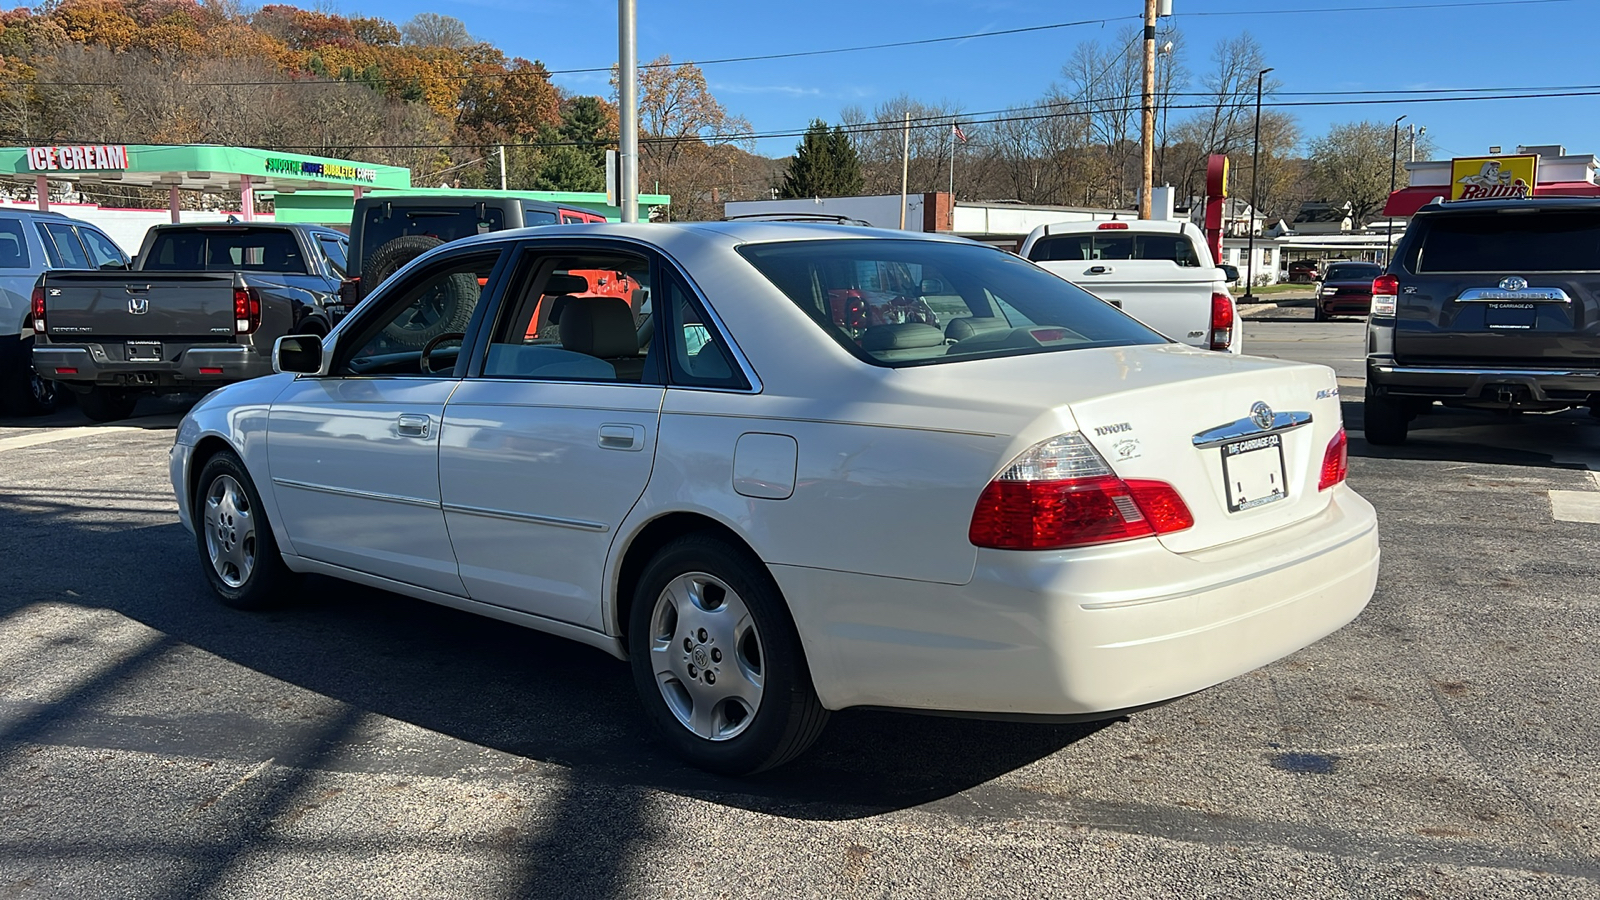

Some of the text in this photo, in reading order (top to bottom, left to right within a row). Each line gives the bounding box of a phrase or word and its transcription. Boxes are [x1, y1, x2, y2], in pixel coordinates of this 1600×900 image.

[27, 146, 128, 170] ICE CREAM
[1094, 422, 1133, 436] TOYOTA
[1228, 443, 1240, 454] THE
[1240, 437, 1269, 452] CARRIAGE
